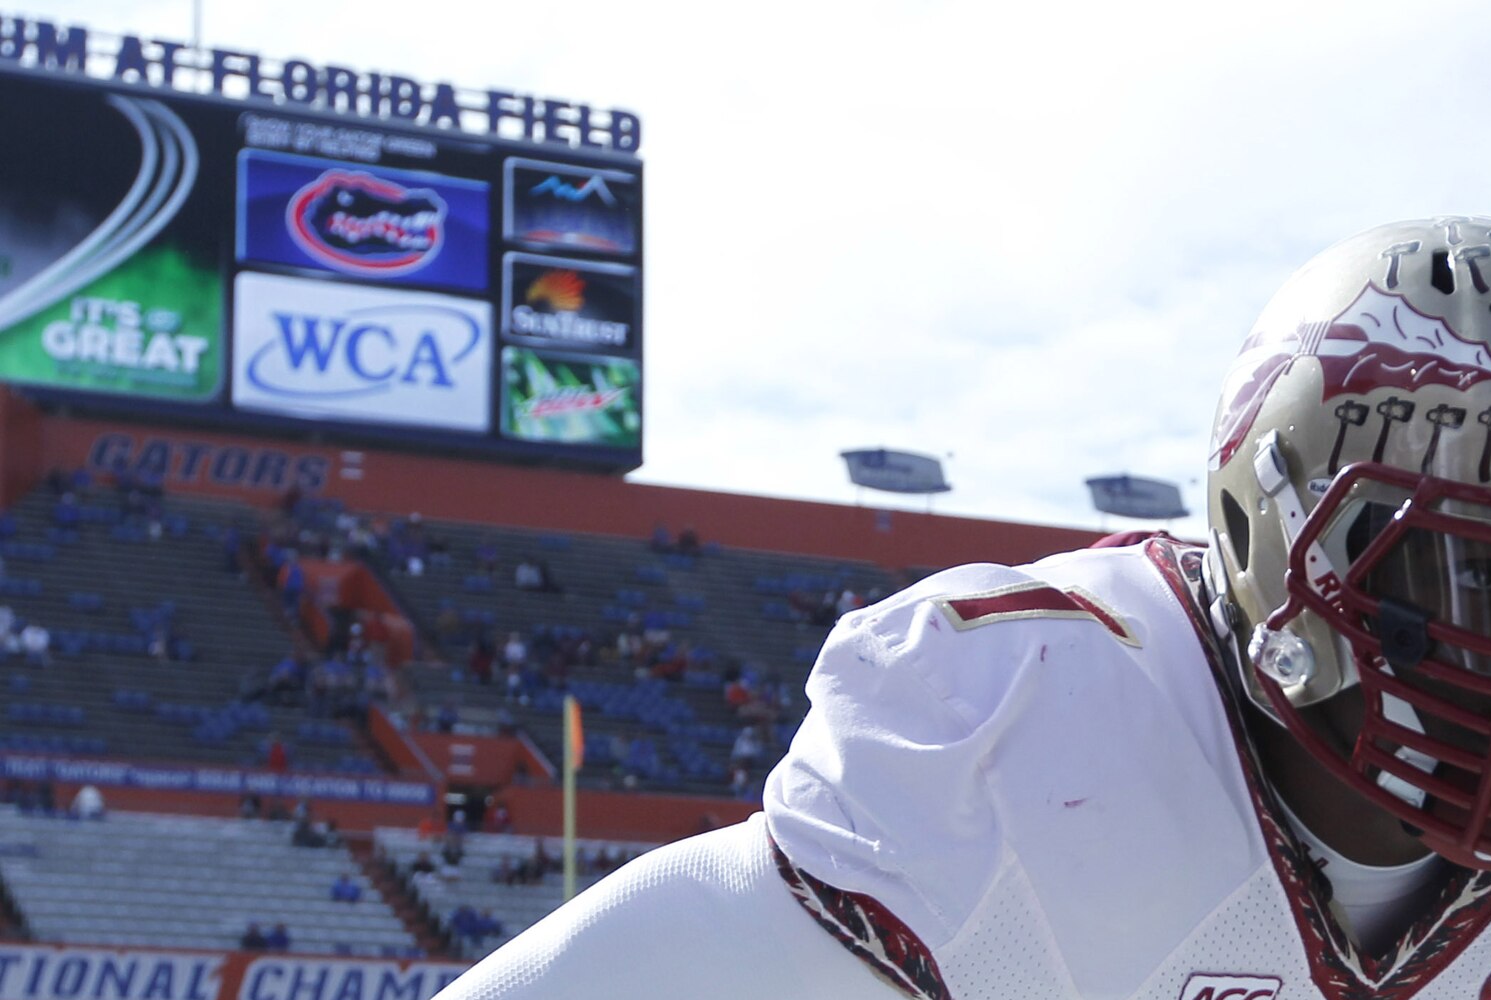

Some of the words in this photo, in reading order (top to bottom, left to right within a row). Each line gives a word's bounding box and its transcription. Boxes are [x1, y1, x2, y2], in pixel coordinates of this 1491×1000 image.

[115, 35, 187, 85] AT
[211, 49, 459, 131] FLORIDA
[487, 90, 641, 153] FIELD
[42, 320, 208, 374] GREAT
[272, 313, 455, 388] WCA
[91, 434, 329, 490] GATORS
